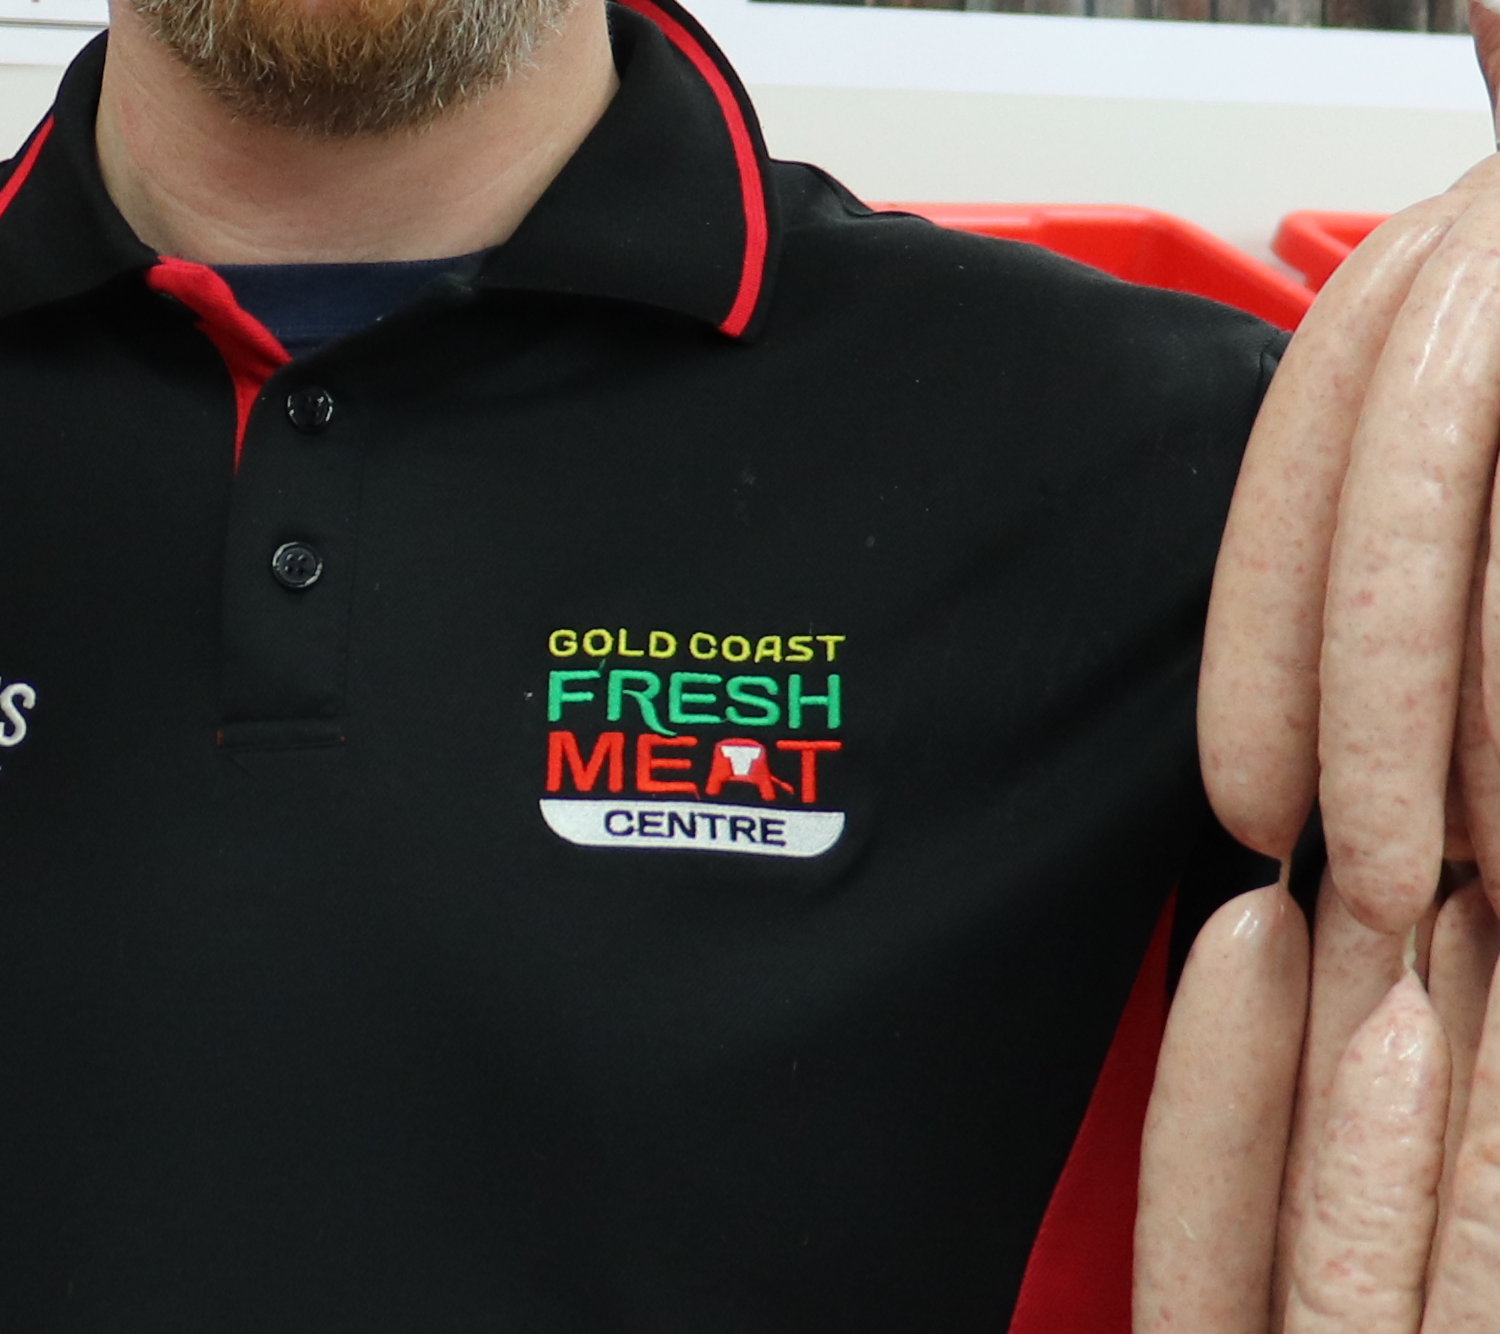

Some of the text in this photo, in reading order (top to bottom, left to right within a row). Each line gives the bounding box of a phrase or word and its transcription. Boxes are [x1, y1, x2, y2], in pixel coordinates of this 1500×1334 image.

[548, 628, 846, 663] GOLD COAST
[547, 669, 841, 736] FRESH
[546, 730, 842, 803] MEAT
[604, 809, 787, 847] CENTRE
